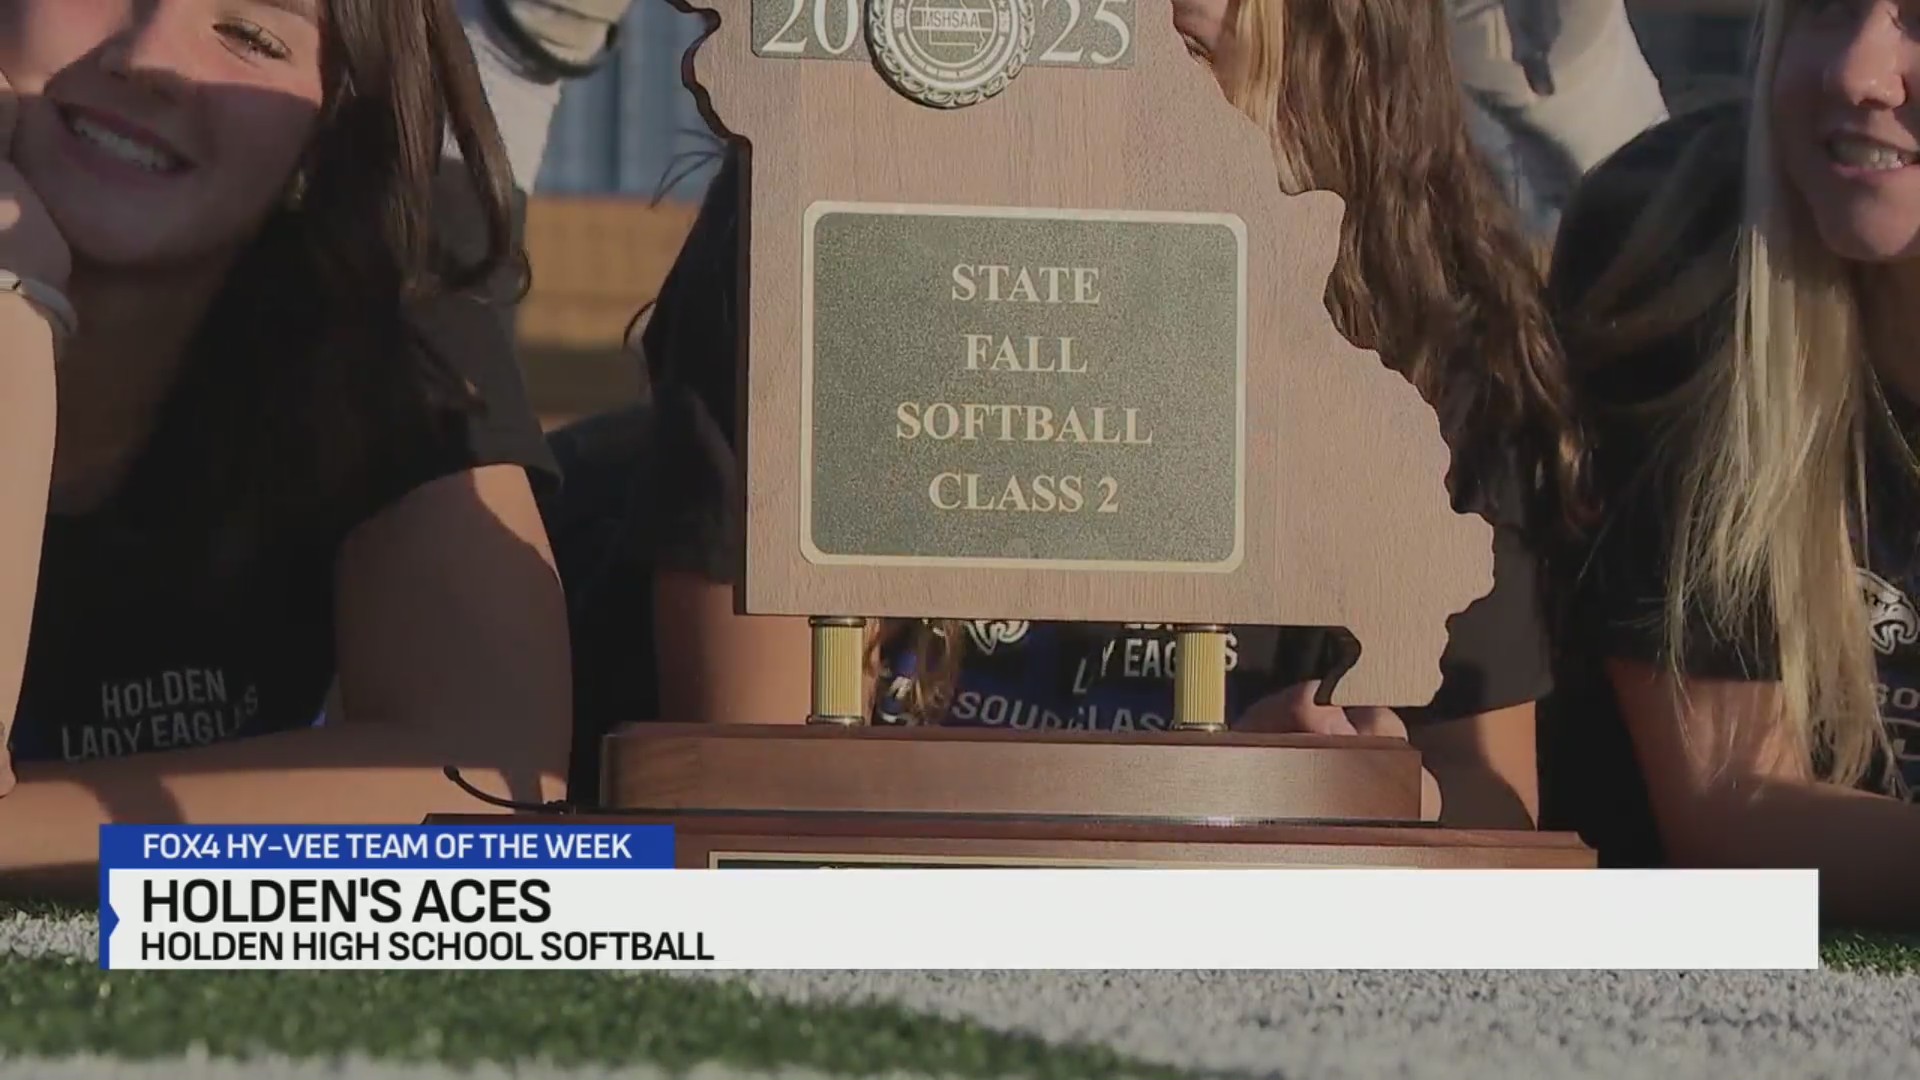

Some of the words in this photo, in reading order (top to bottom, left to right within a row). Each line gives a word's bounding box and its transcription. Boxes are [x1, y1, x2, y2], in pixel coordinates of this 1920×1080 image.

[761, 0, 859, 55] 20
[1039, 0, 1131, 65] 25
[923, 9, 980, 28] MSHSAA
[951, 263, 1101, 305] STATE
[963, 333, 1088, 374] FALL
[895, 401, 1153, 445] SOFTBALL
[928, 472, 1084, 513] CLASS
[1097, 476, 1119, 513] 2
[101, 668, 227, 720] HOLDEN
[61, 721, 143, 762] LADY
